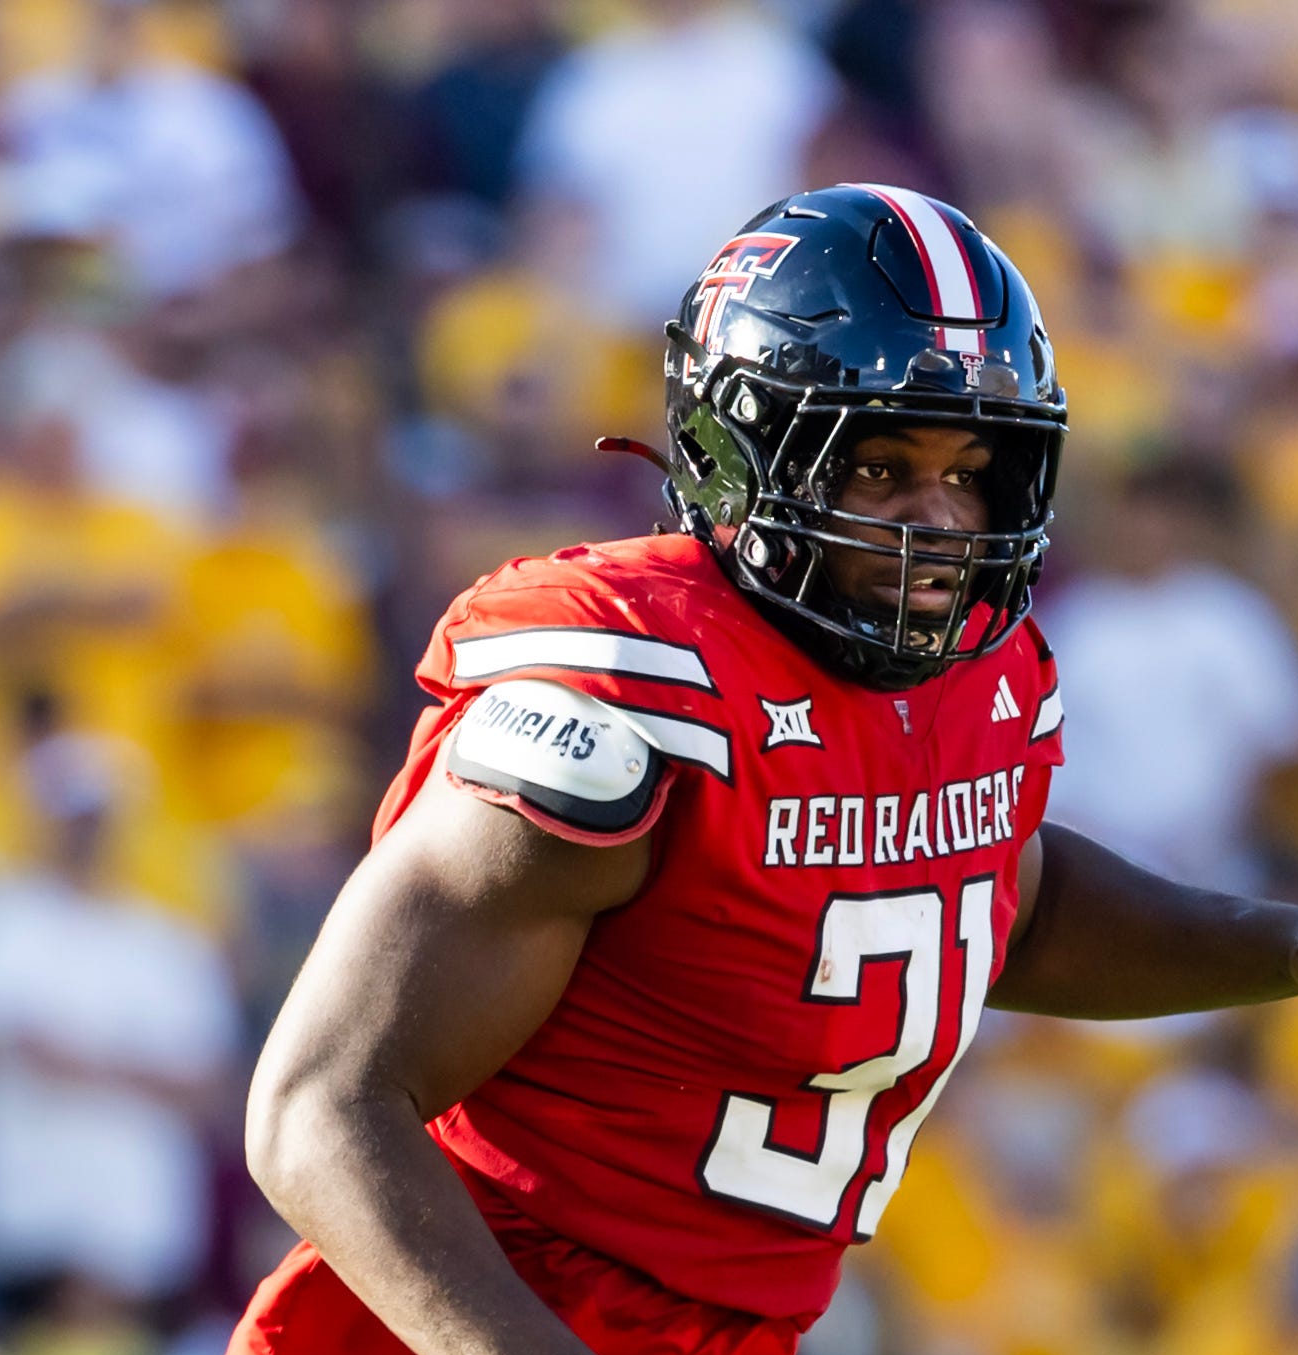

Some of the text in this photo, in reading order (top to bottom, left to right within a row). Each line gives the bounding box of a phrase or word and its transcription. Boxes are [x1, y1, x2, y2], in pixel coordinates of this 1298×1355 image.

[471, 694, 610, 761] OUGLAS
[763, 796, 866, 867] RED
[701, 877, 996, 1242] 31
